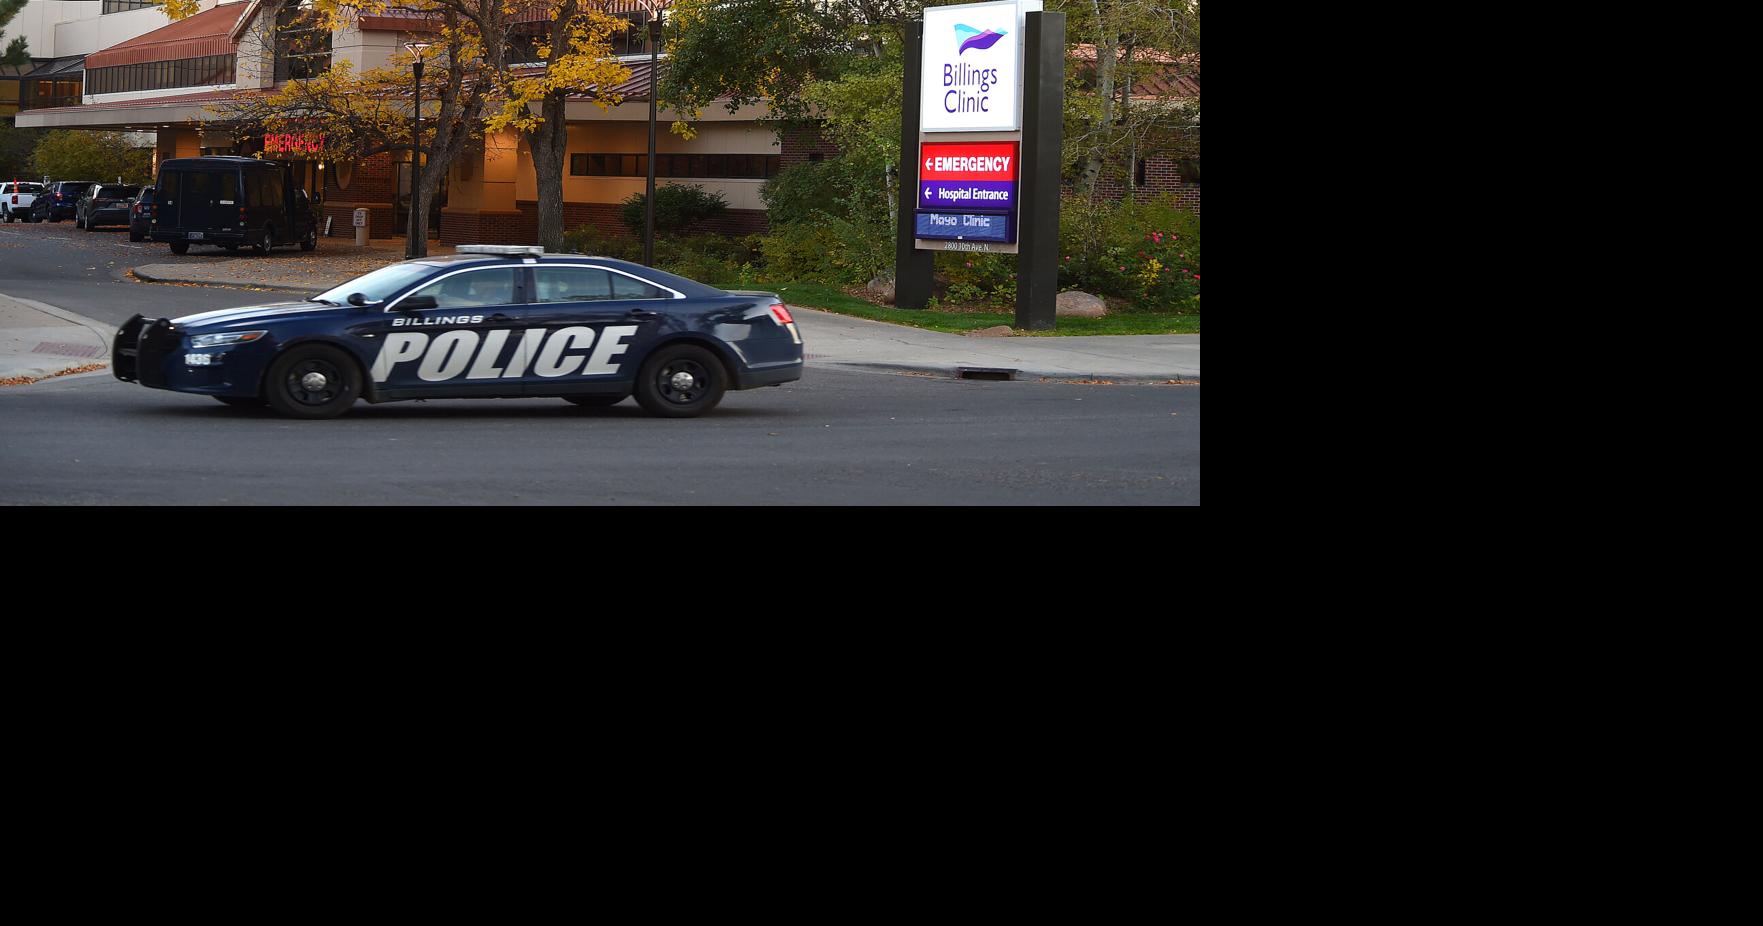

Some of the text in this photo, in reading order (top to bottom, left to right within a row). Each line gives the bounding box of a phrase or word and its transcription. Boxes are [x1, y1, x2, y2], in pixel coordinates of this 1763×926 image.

[943, 63, 997, 92] Billings
[944, 90, 989, 113] Clinic
[934, 156, 1010, 172] EMERGENCY
[938, 188, 1009, 202] Hospital Entrance
[930, 213, 990, 227] Mayo Clinic
[391, 315, 484, 326] BILLINGS
[370, 325, 638, 383] POLICE
